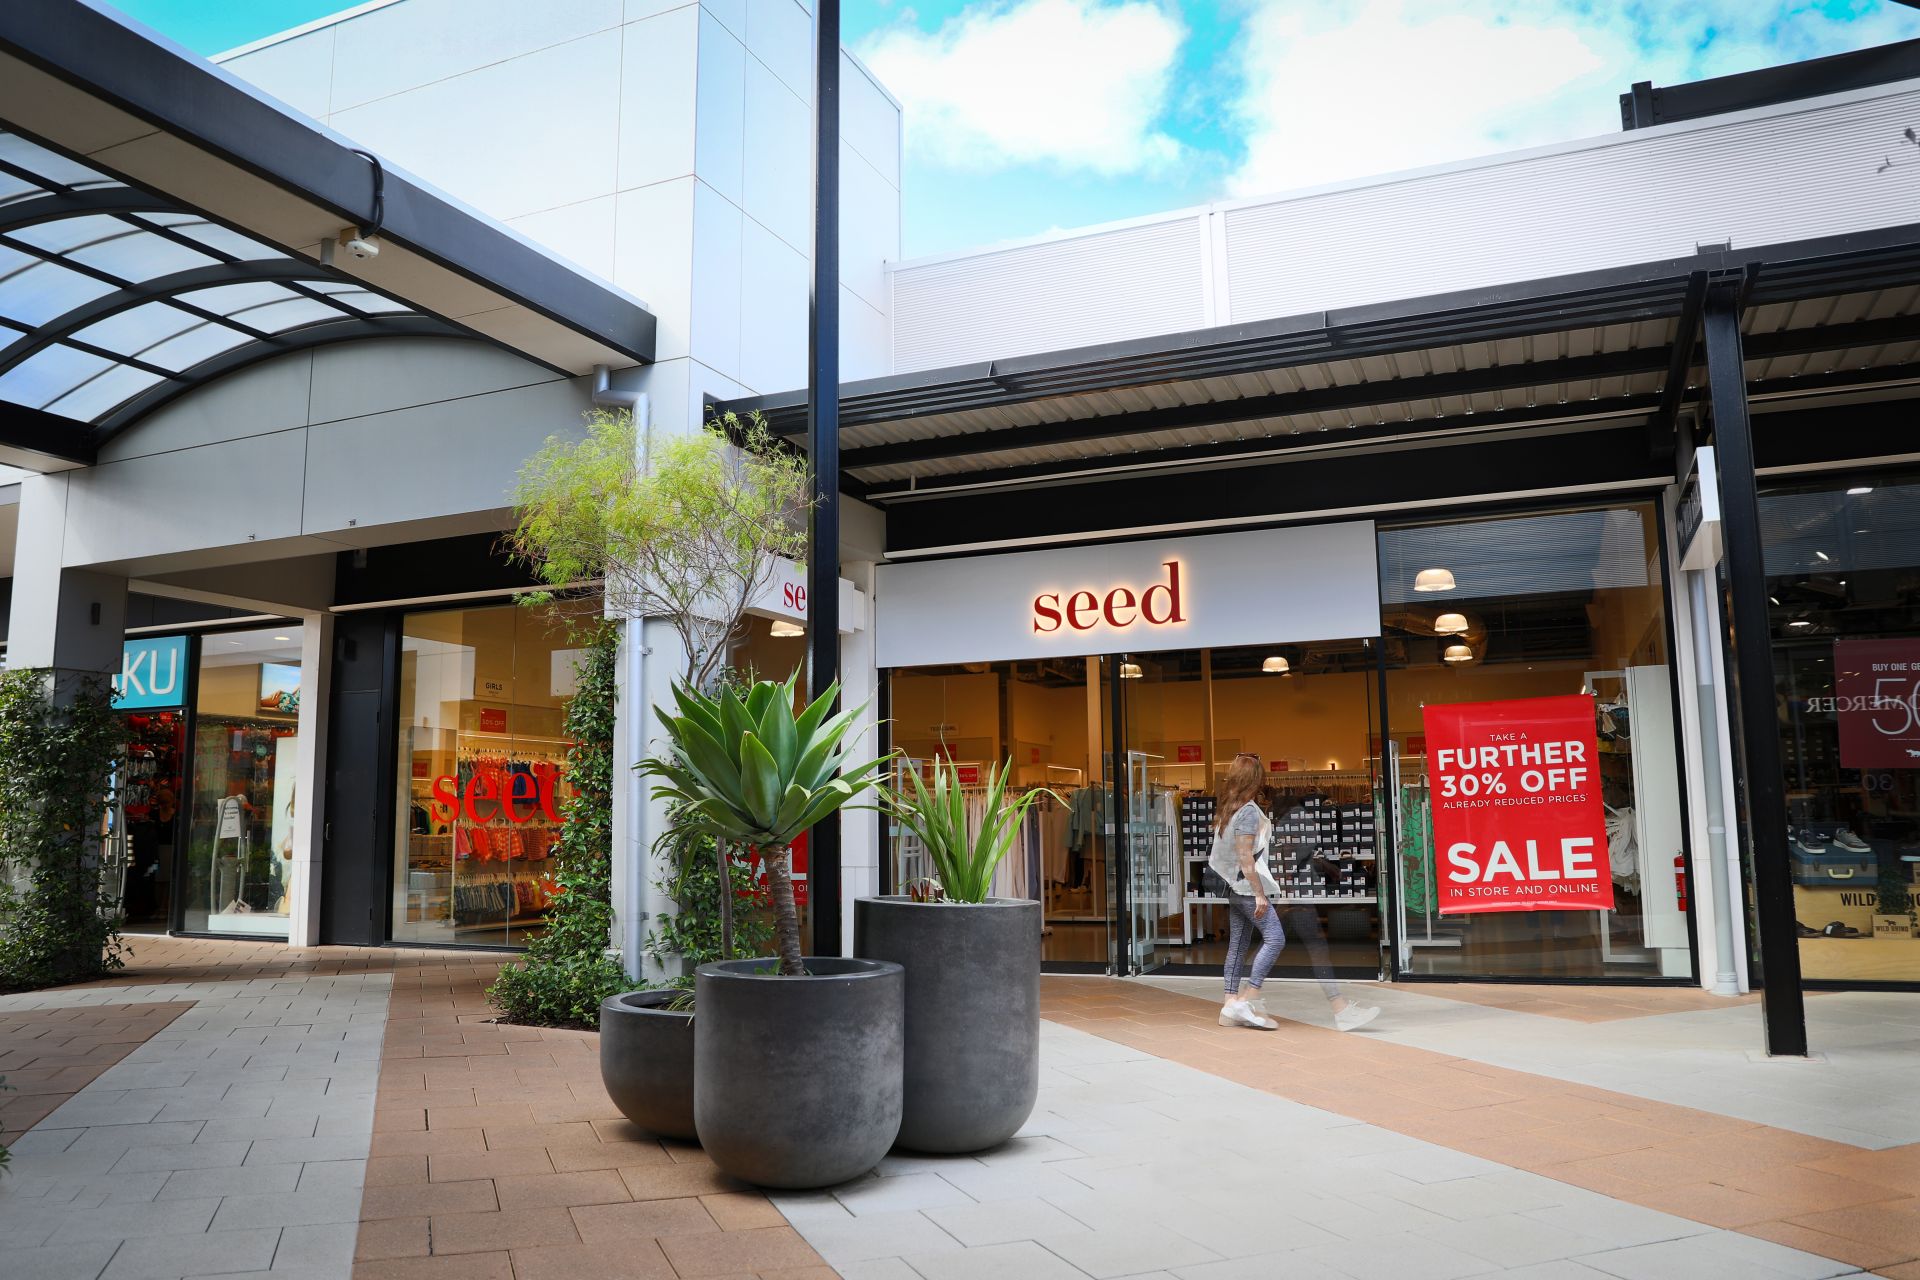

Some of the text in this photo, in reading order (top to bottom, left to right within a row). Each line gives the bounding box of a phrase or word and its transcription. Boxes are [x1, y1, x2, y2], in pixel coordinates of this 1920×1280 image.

[783, 582, 806, 611] se
[1033, 561, 1186, 633] seed
[111, 647, 177, 697] KU
[1872, 663, 1888, 671] BUY
[1891, 663, 1908, 671] ONE
[485, 682, 503, 691] GIRLS
[1871, 678, 1920, 735] 5
[1490, 732, 1527, 742] TAKE A
[1437, 740, 1586, 771] FURTHER
[1440, 767, 1588, 798] 30% OFF
[1443, 799, 1490, 809] ALREADY
[1494, 796, 1544, 807] REDUCED
[1447, 836, 1598, 884] SALE
[1450, 883, 1599, 897] IN STORE AND ONLINE
[1840, 892, 1876, 907] WILD
